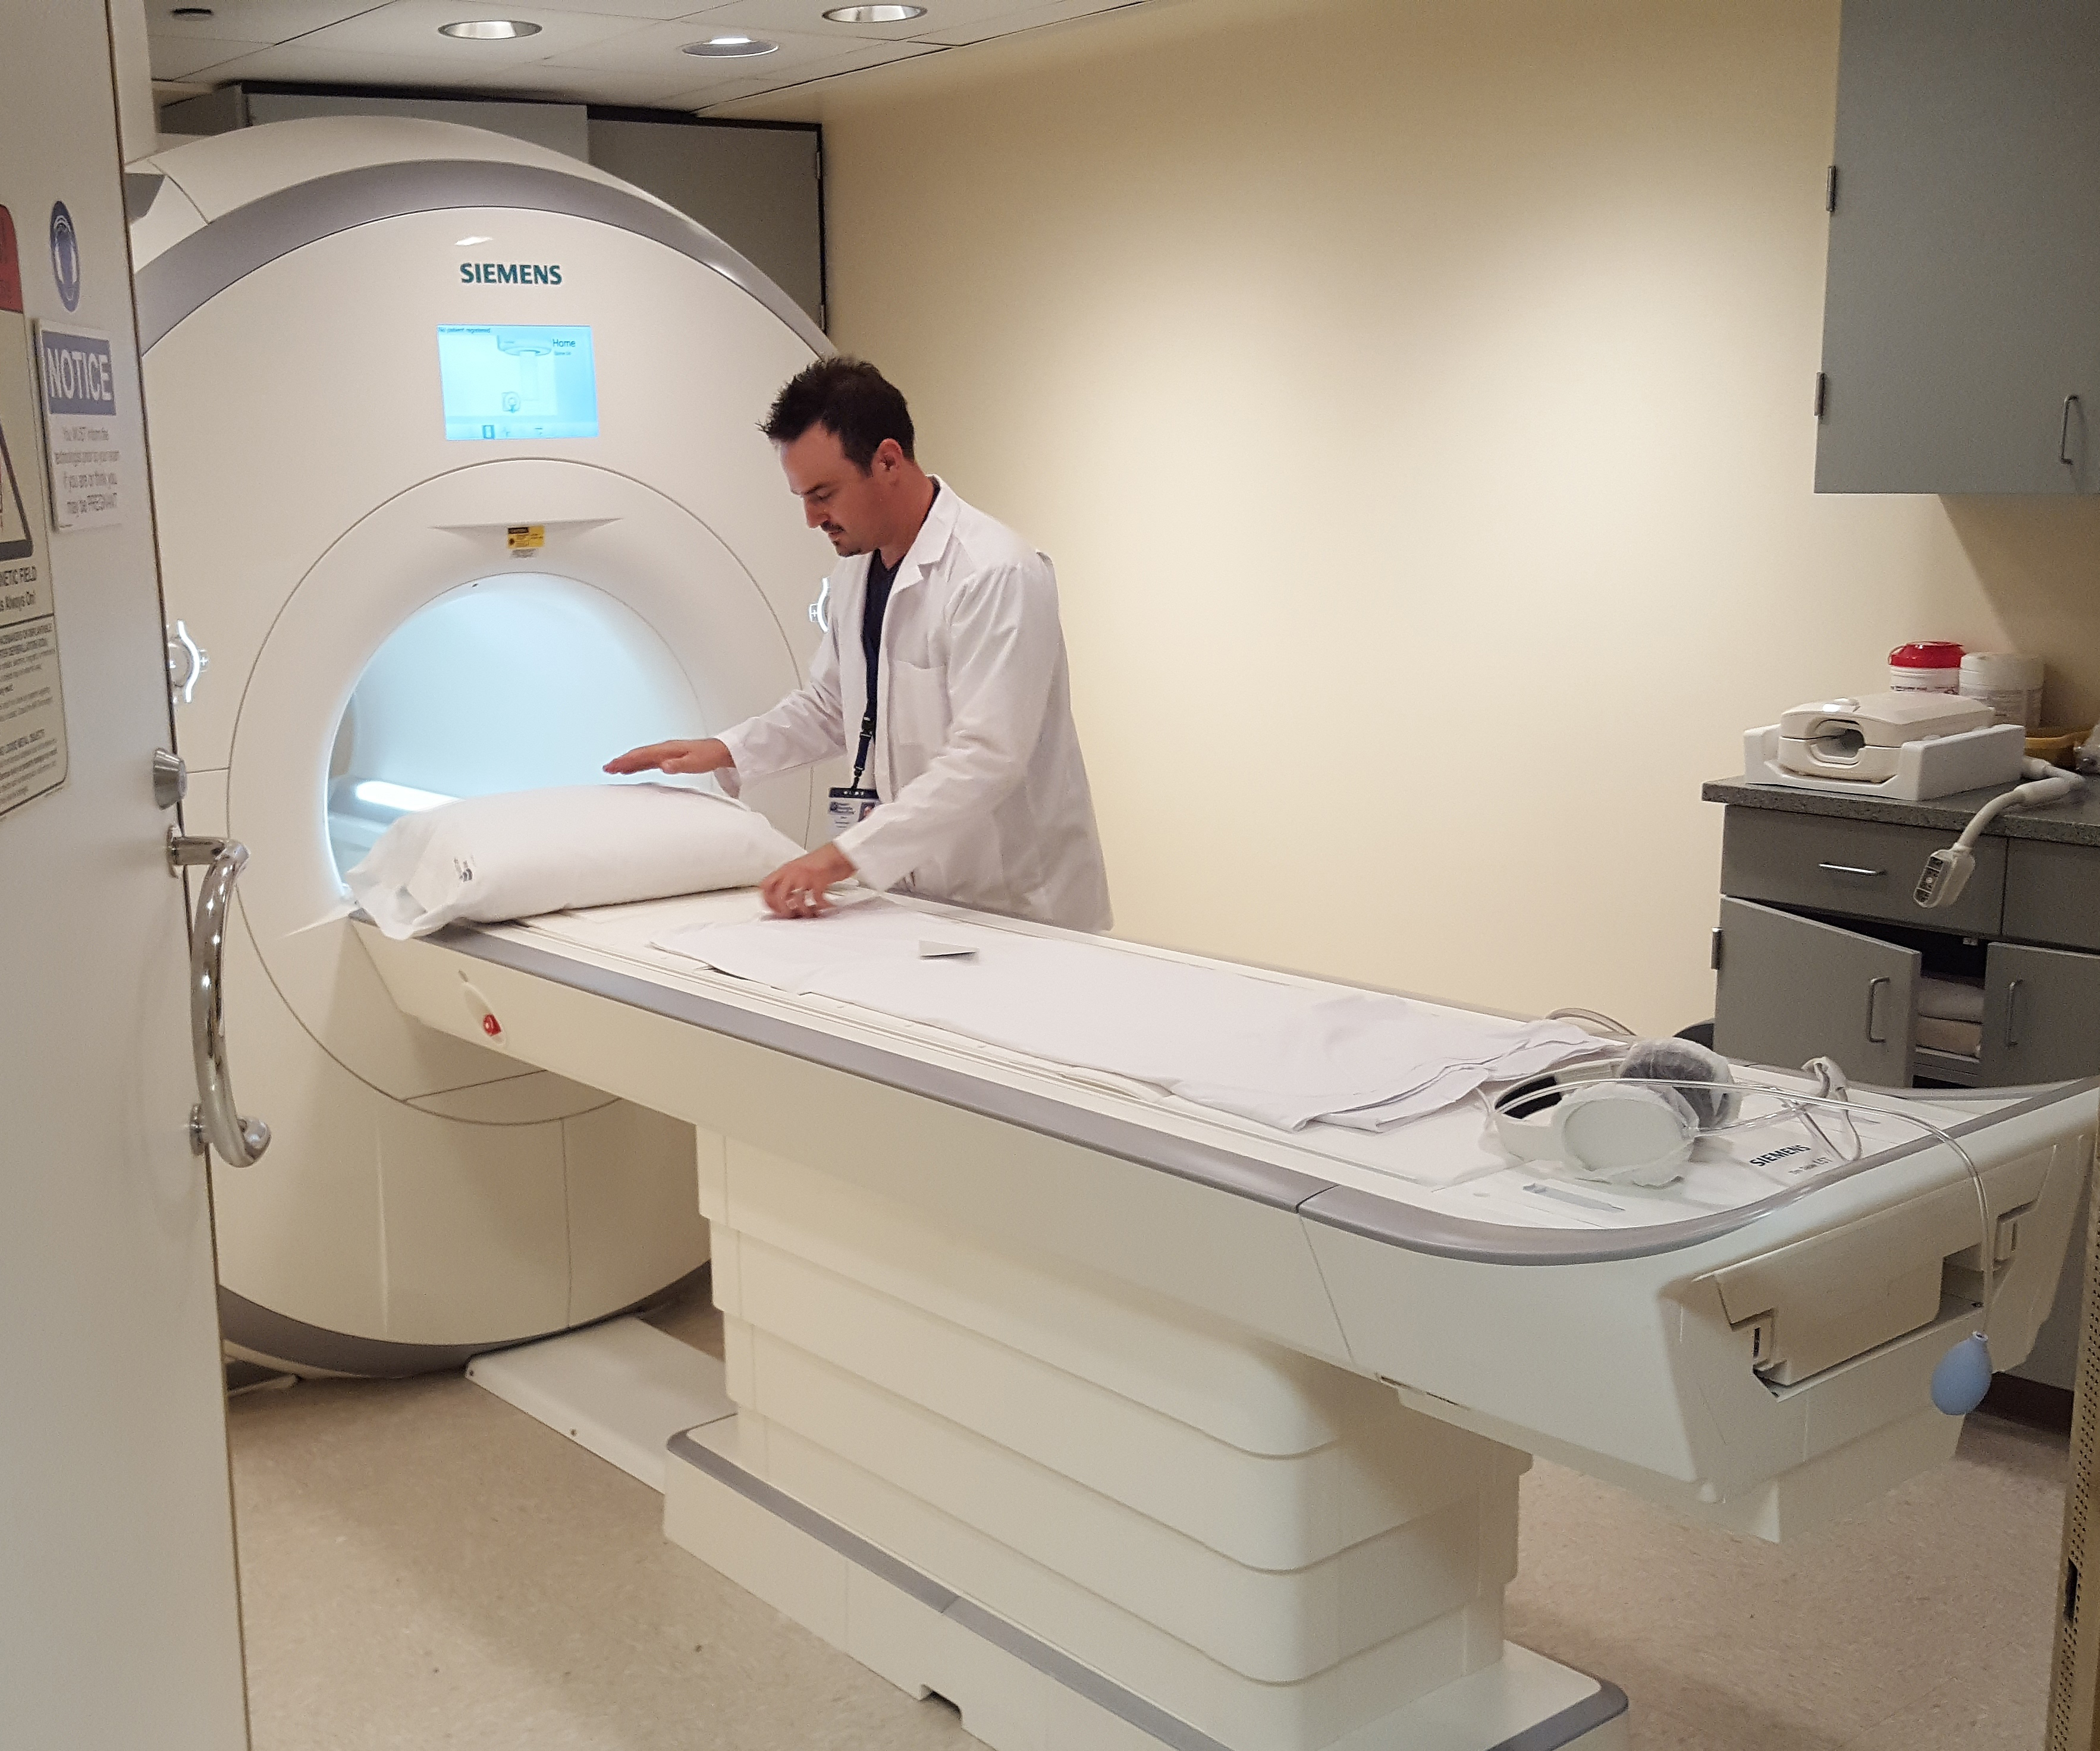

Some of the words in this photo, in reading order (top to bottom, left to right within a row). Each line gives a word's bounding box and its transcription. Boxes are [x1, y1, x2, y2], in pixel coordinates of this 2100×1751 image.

[460, 263, 563, 285] SIEMENS
[553, 338, 576, 347] Home
[47, 348, 112, 401] NOTICE
[19, 565, 37, 582] FIELD
[1749, 1144, 1812, 1167] SIEMENS
